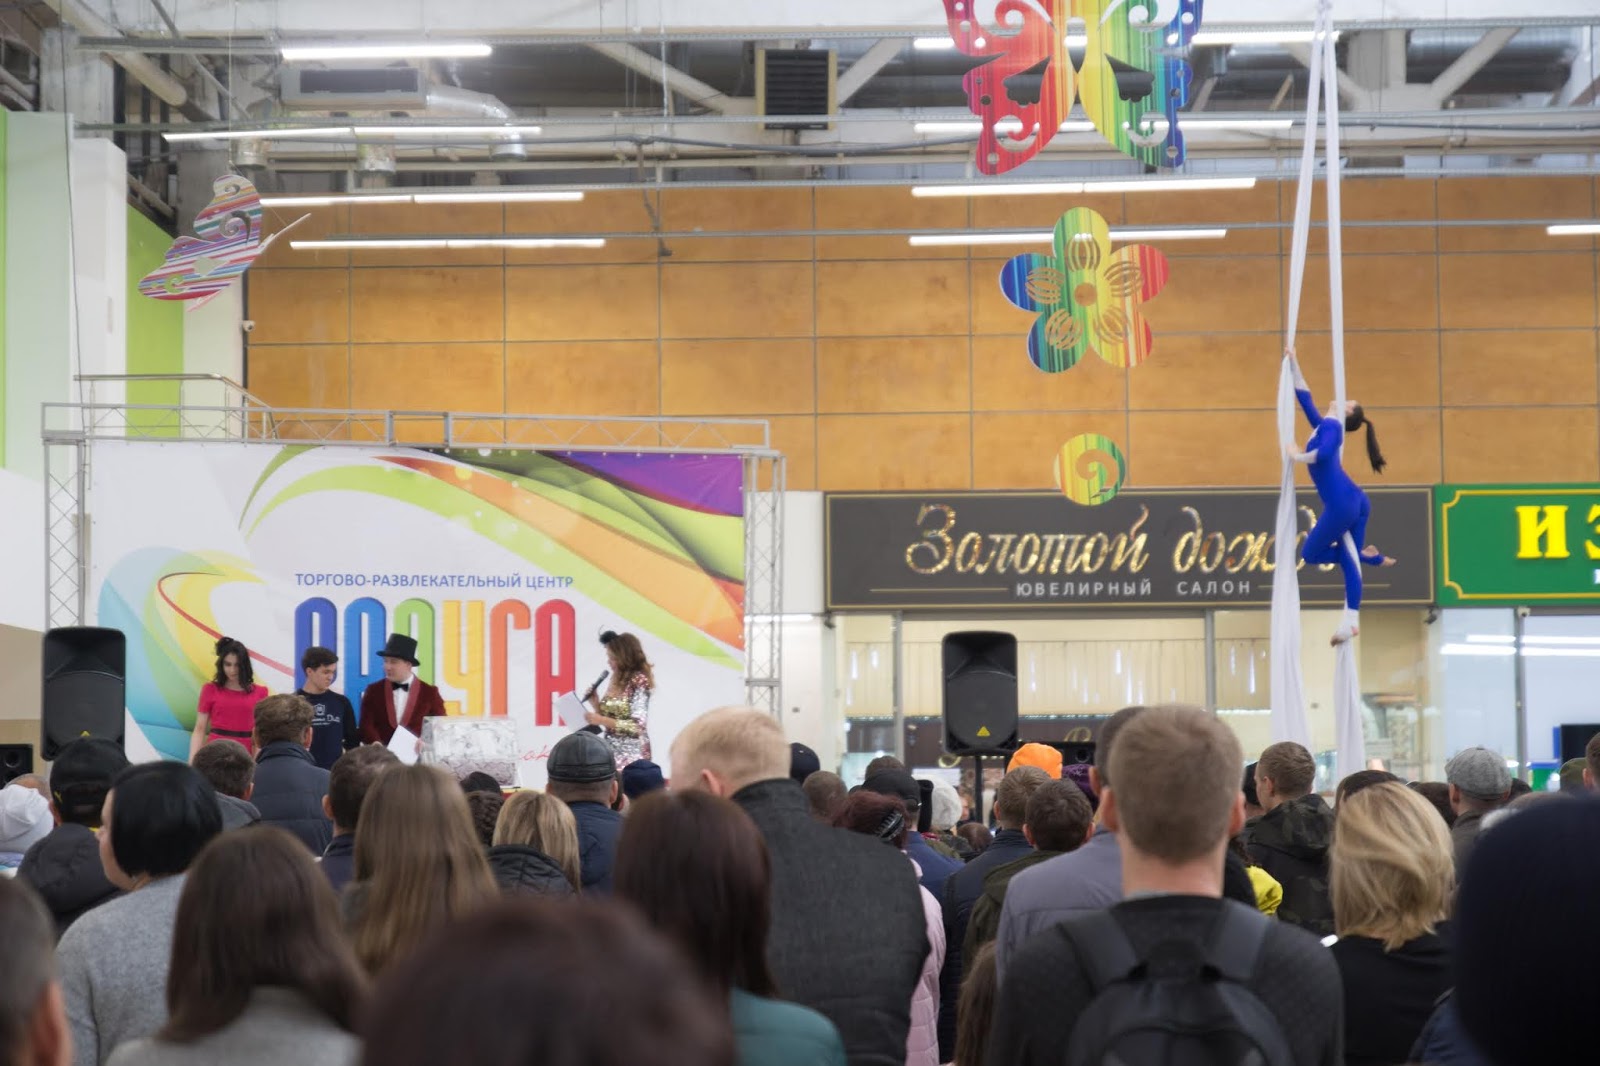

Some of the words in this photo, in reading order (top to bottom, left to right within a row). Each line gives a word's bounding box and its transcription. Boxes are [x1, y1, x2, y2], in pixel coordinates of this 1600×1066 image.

[905, 503, 1149, 574] Золотой
[1173, 505, 1335, 573] дожд
[295, 571, 522, 588] ТОРГОВО-РАЗВЛЕКАТЕЛЬНЫЙ
[526, 575, 574, 590] ЦЕНТР
[1016, 580, 1152, 597] ЮВЕЛИРНЫЙ
[1177, 580, 1251, 596] САЛОН
